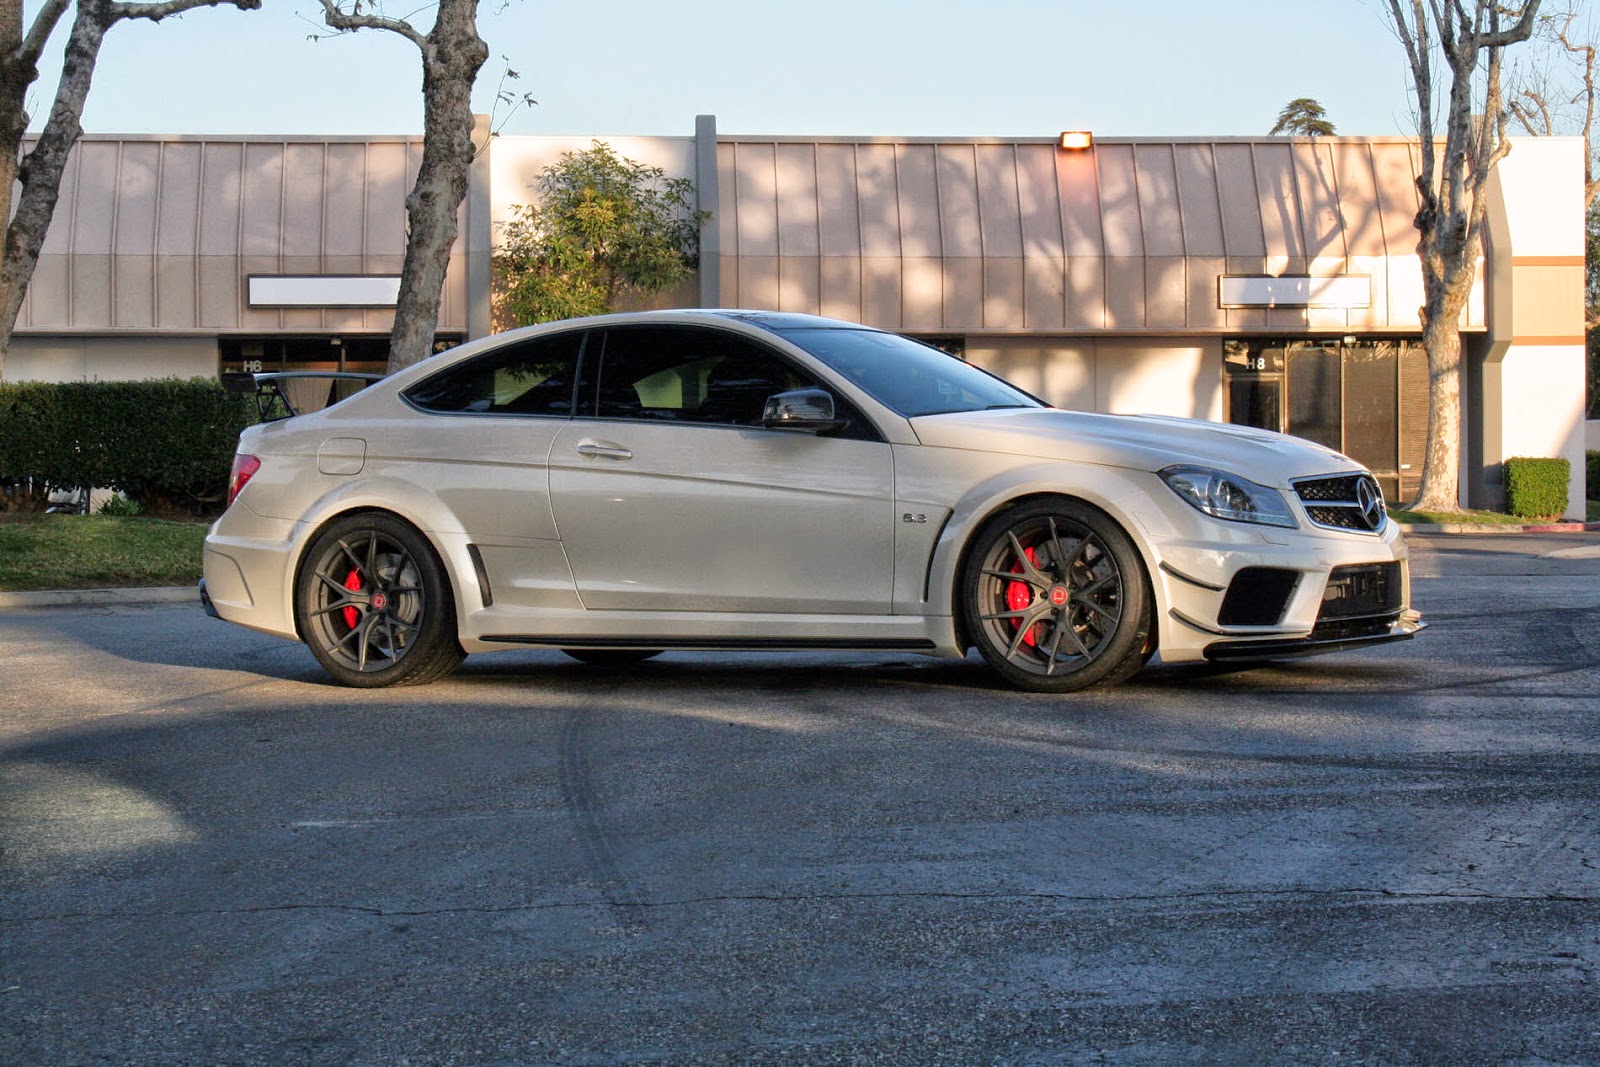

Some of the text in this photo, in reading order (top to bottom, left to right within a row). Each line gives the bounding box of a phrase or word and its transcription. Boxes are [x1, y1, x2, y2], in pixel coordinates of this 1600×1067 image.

[243, 360, 263, 372] H6
[1246, 357, 1265, 370] H8
[903, 513, 927, 524] 6.3
